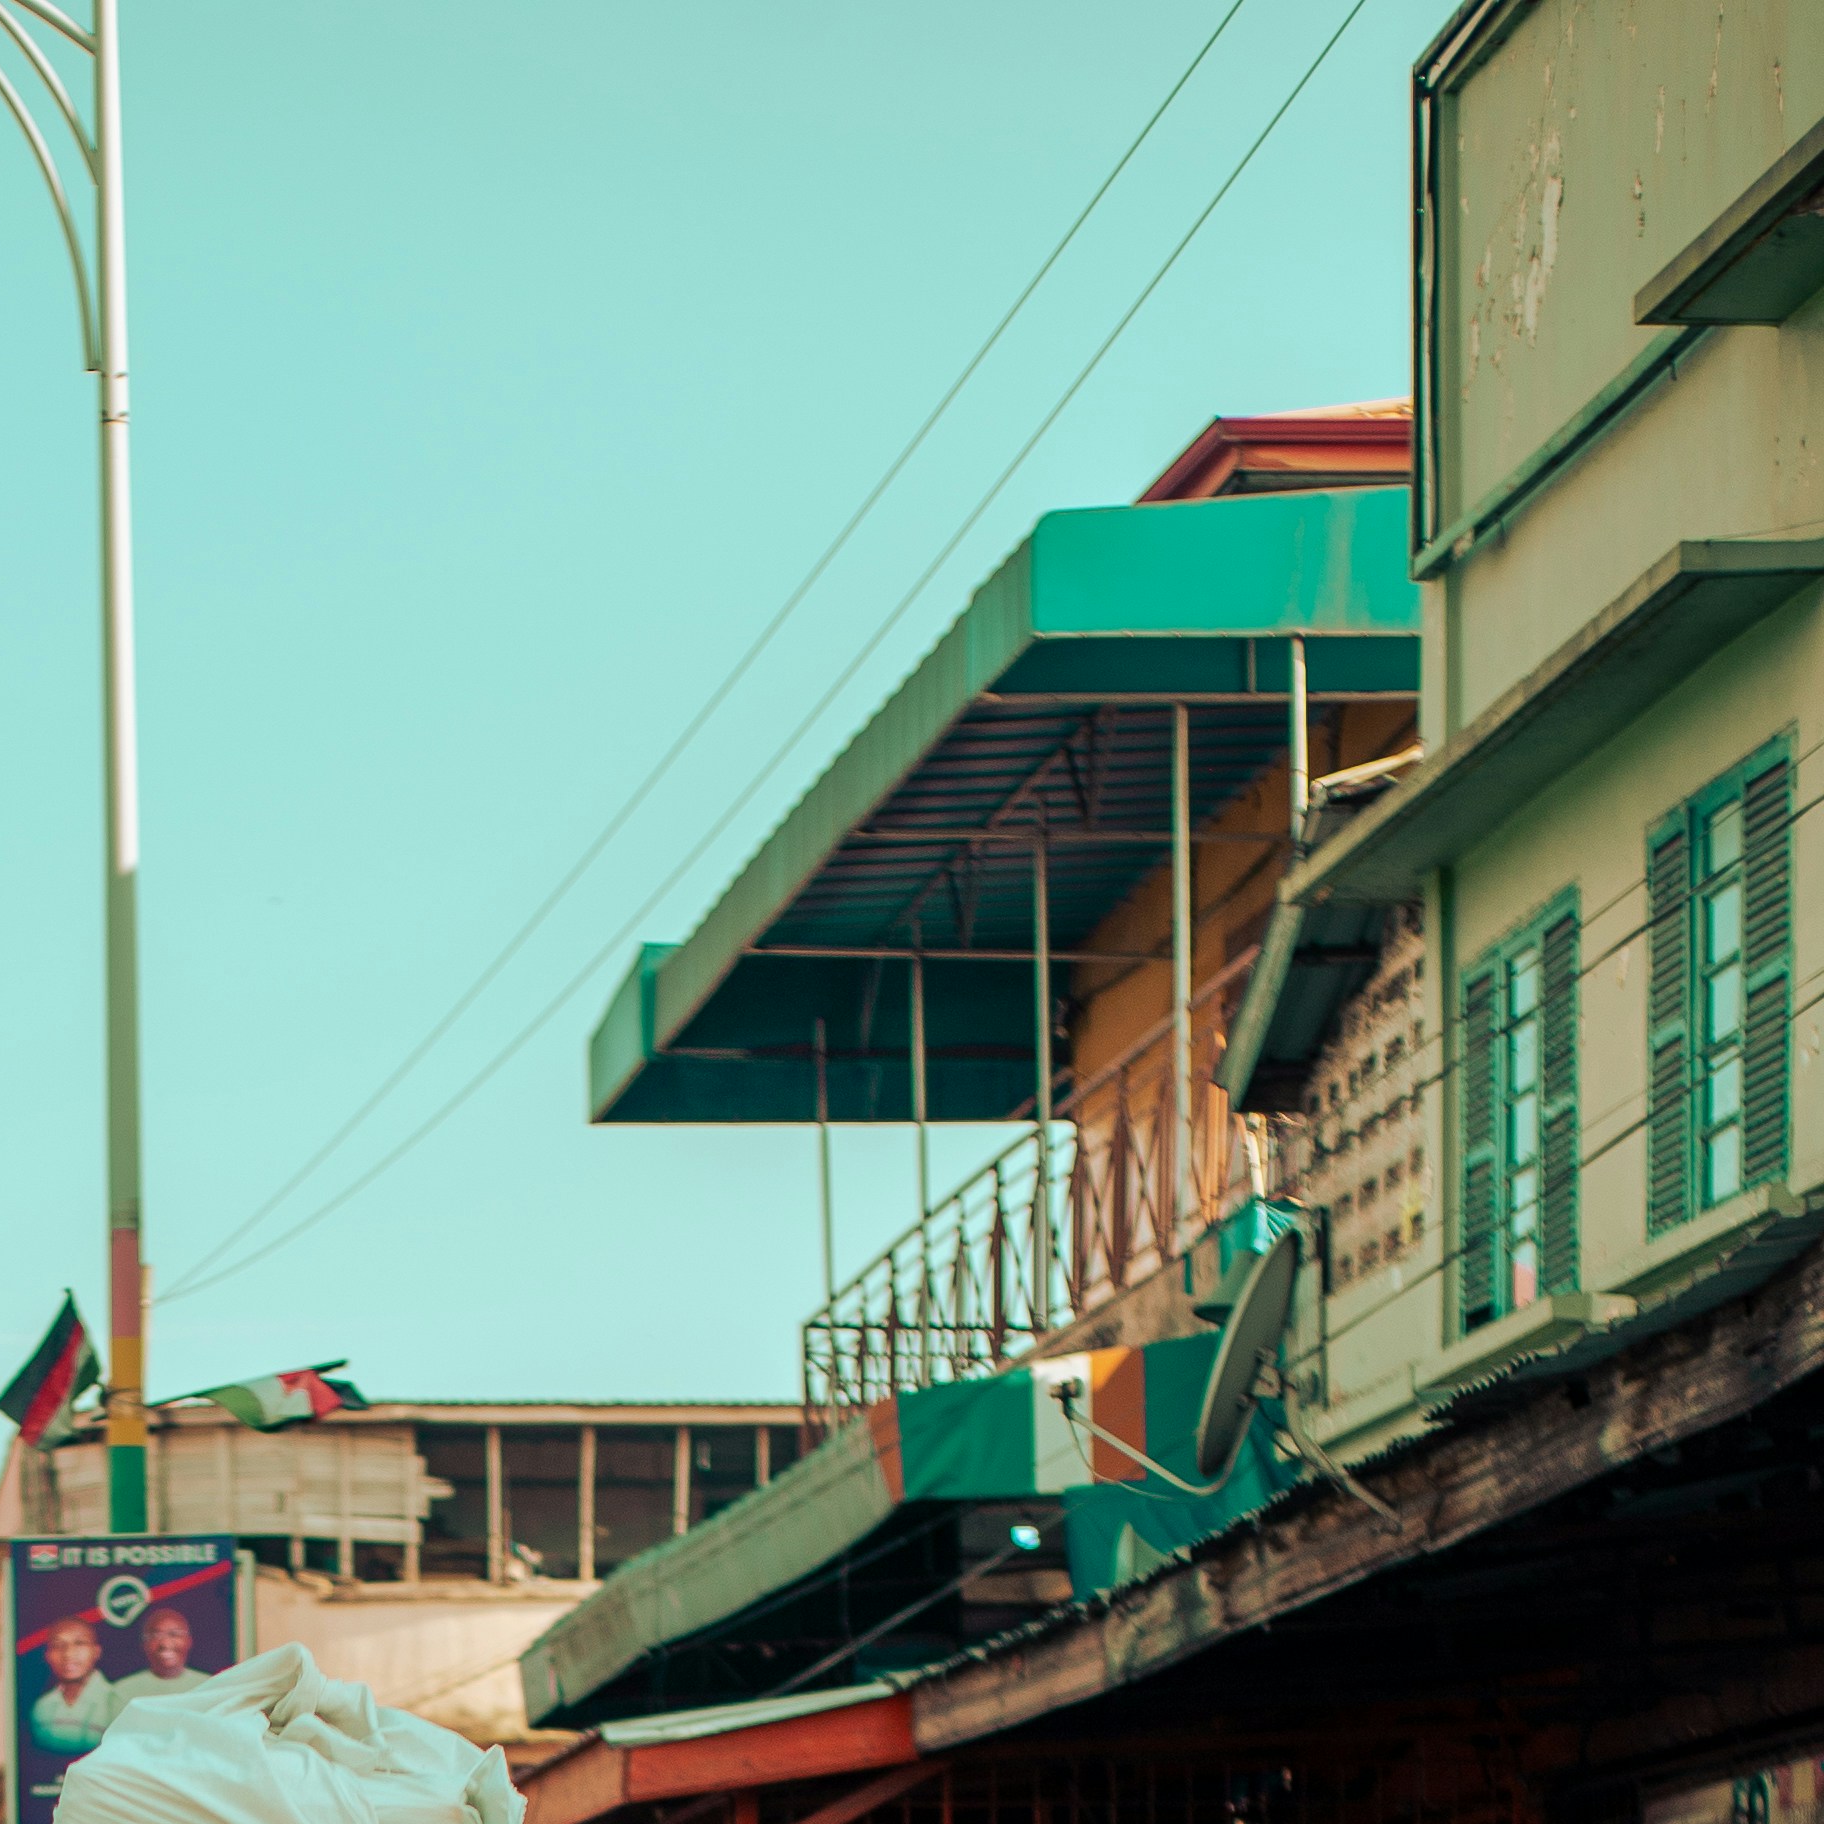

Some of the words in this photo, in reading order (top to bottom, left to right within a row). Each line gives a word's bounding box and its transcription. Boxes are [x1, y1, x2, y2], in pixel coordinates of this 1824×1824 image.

[63, 1547, 82, 1565] IT
[87, 1546, 109, 1565] IS
[114, 1544, 217, 1564] POSSIBLE
